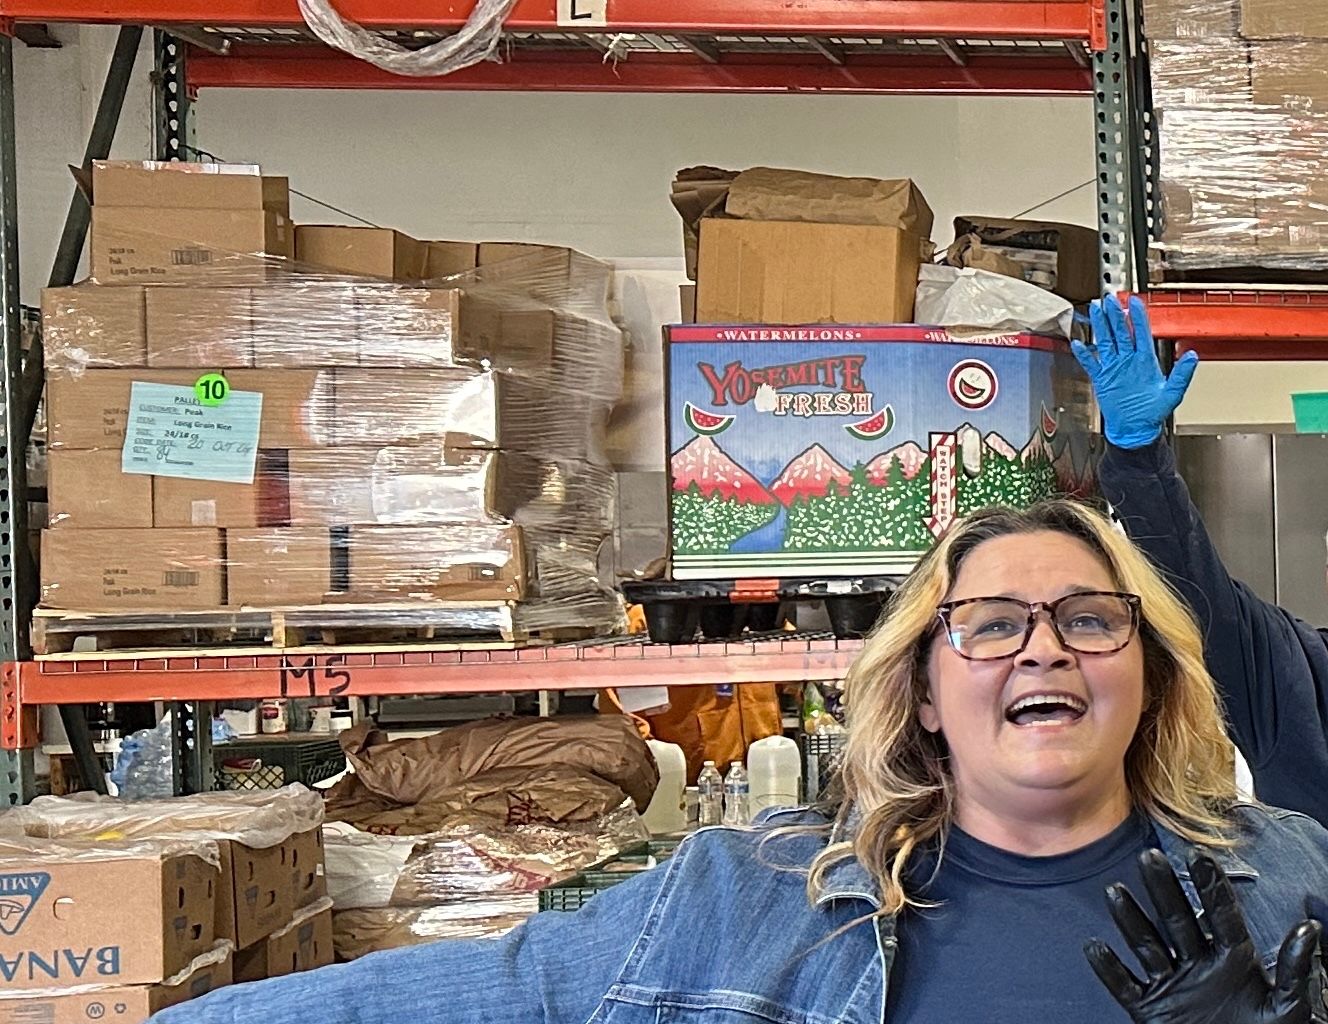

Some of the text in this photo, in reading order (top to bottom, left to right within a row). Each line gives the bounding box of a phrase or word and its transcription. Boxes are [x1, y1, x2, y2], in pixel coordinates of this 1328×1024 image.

[724, 330, 854, 341] WATERMELONS
[200, 379, 225, 400] 10
[698, 355, 867, 406] YOSEMITE
[774, 392, 874, 416] FRESH
[938, 449, 948, 489] WATCH
[938, 492, 948, 523] STEP
[280, 655, 351, 698] M5
[0, 877, 43, 891] AMI
